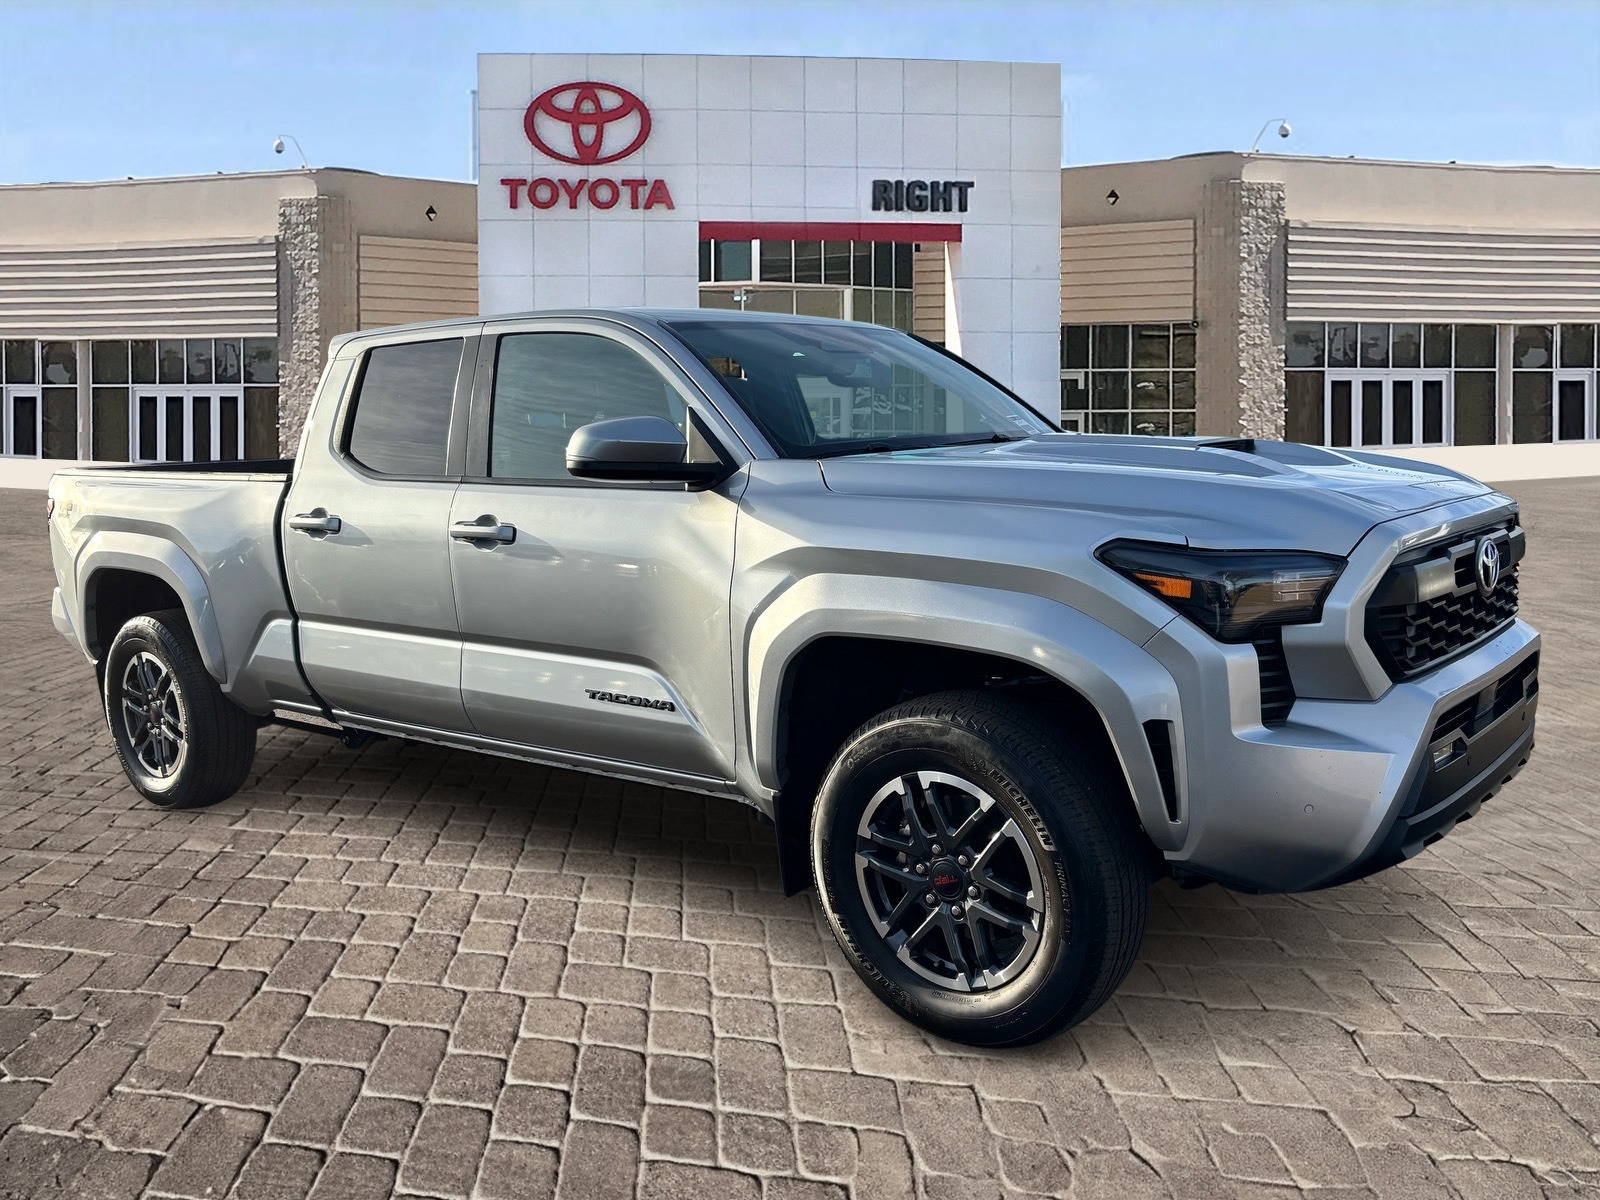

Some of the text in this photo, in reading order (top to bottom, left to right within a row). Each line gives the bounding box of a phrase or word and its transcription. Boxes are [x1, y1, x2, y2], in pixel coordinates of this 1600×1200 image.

[500, 178, 675, 209] TOYOTA
[871, 180, 975, 213] RIGHT
[585, 689, 676, 712] TACOMA
[989, 769, 1054, 847] MICHELIN
[1054, 861, 1071, 913] PRIMACY
[838, 917, 891, 988] MICHELIN
